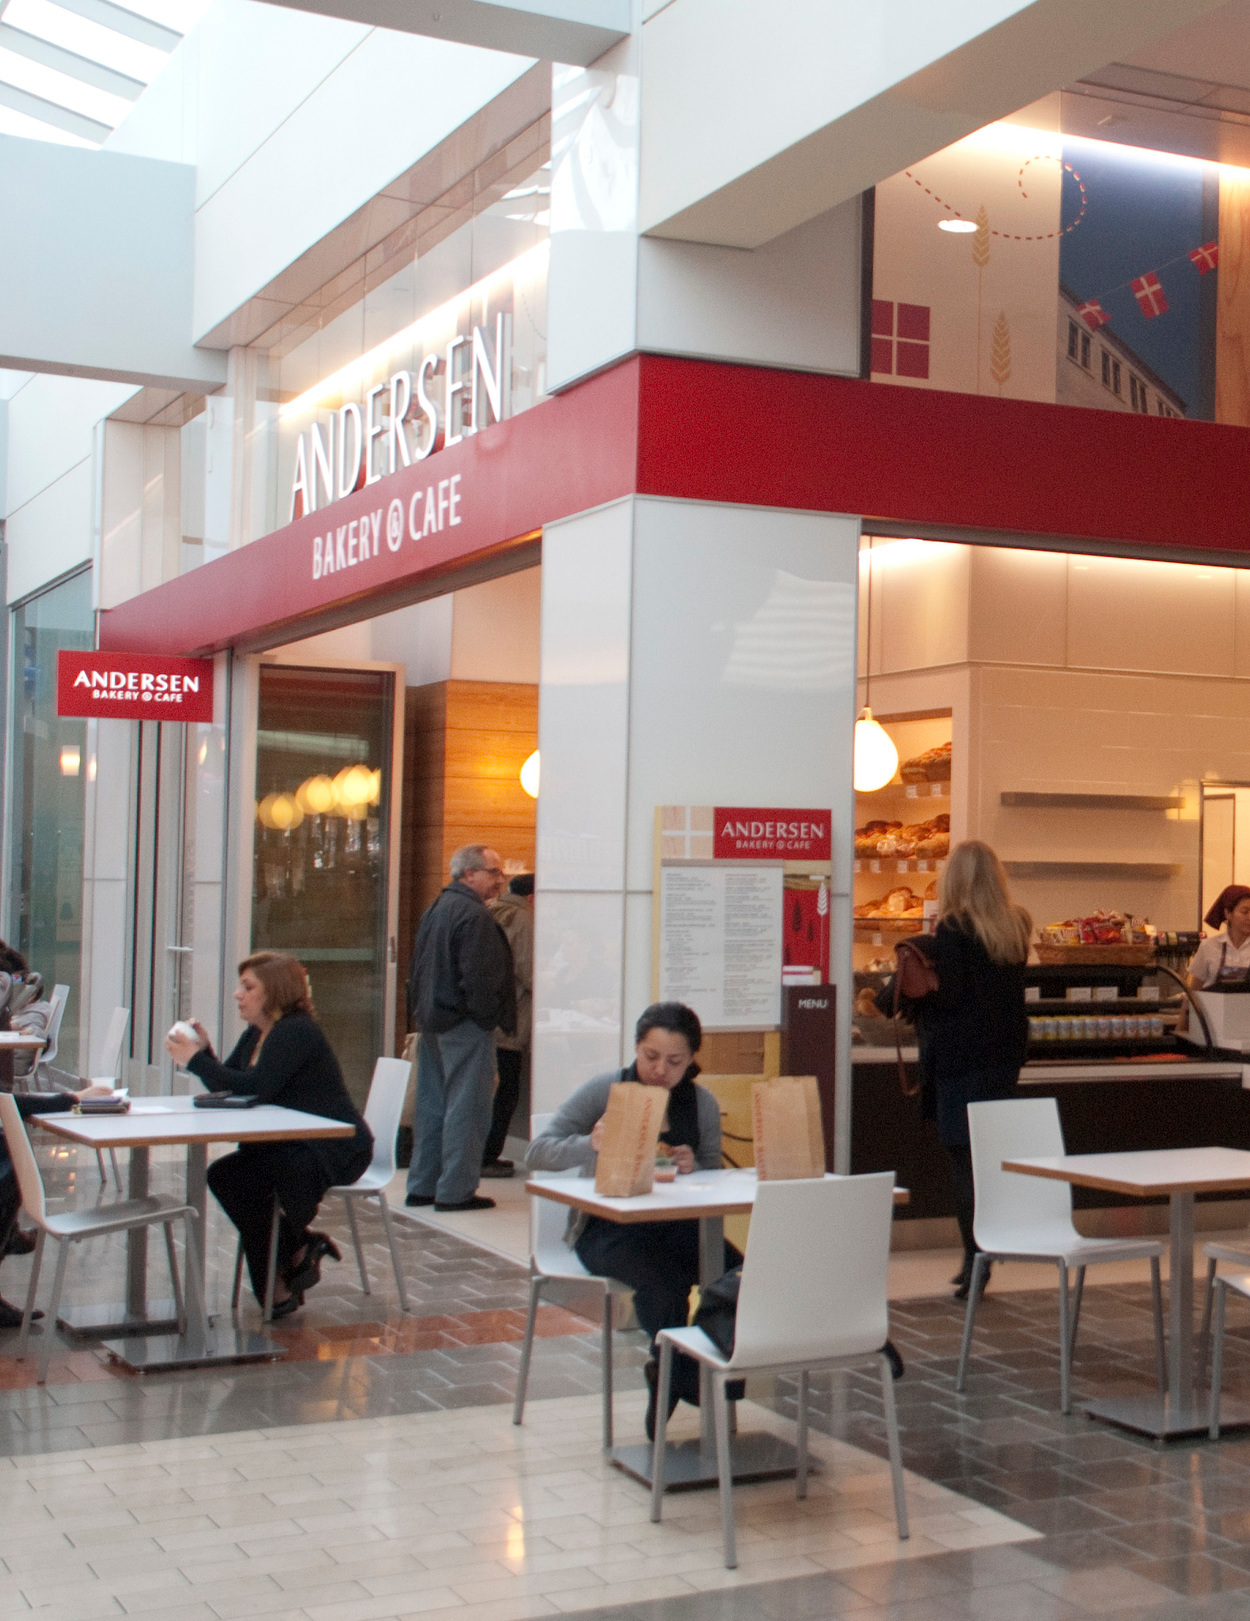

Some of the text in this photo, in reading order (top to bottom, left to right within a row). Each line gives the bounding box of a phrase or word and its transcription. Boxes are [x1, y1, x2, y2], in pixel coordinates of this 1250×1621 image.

[289, 311, 507, 523] ANDERSEN
[312, 508, 383, 580] BAKERY
[409, 474, 462, 541] CAFE
[73, 669, 200, 693] ANDERSEN
[93, 689, 139, 701] BAKERY
[154, 692, 183, 702] CAFE
[721, 821, 824, 839] ANDERSEN
[736, 839, 774, 850] BAKERY
[787, 840, 811, 850] CAFE
[798, 999, 828, 1009] MENU
